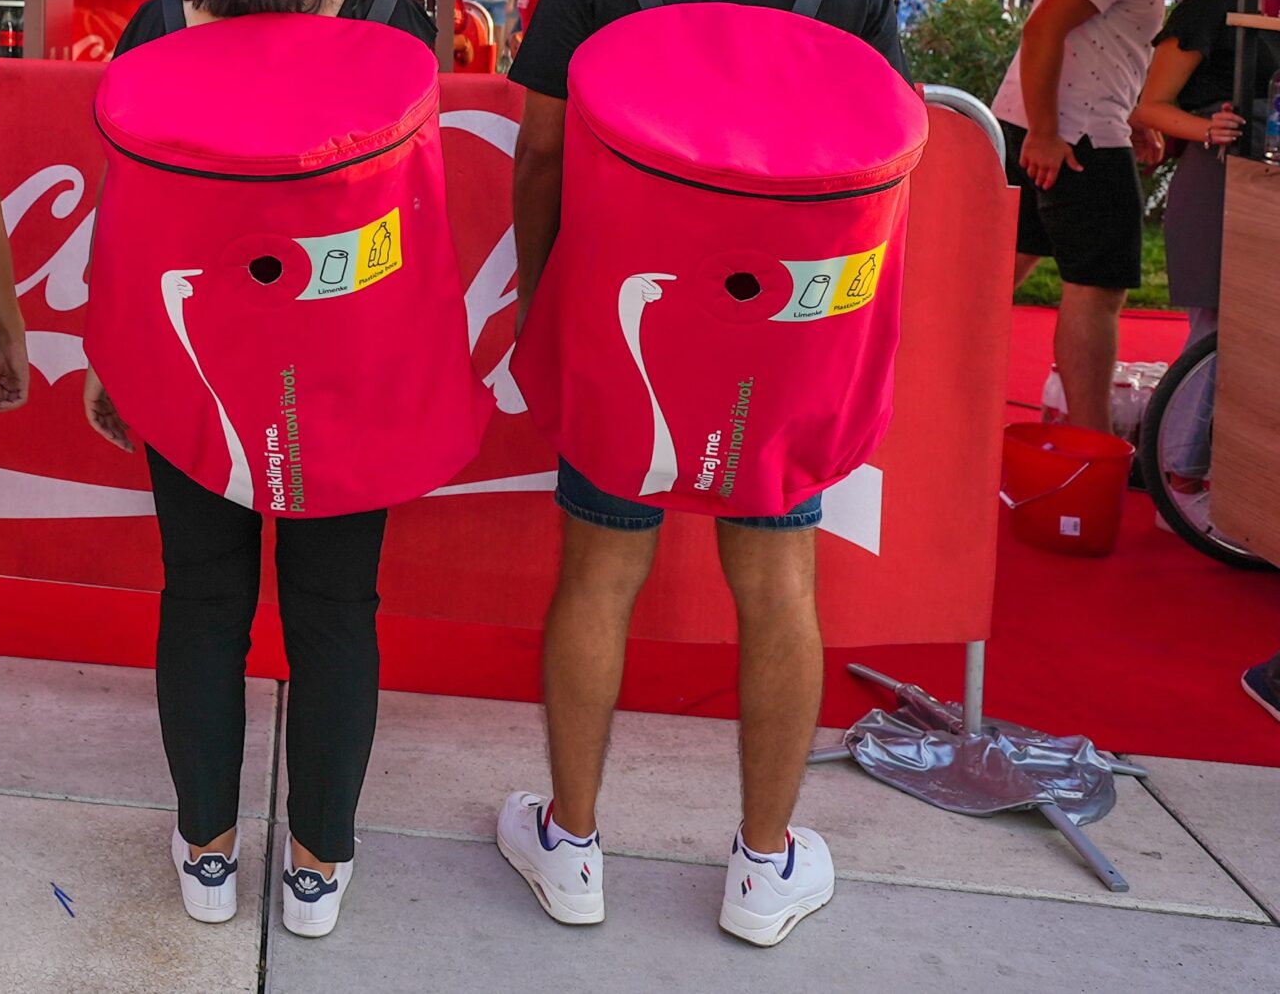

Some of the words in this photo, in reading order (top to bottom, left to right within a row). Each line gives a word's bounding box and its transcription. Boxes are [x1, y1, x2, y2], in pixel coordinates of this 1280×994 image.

[280, 364, 296, 406] život.
[730, 377, 754, 417] život.
[266, 424, 279, 451] me.
[281, 408, 298, 441] novi
[730, 419, 746, 450] novi
[284, 443, 301, 461] mi
[706, 430, 722, 456] me.
[724, 452, 740, 469] mi
[264, 452, 286, 511] Recikliraj
[286, 464, 305, 512] Pokloni
